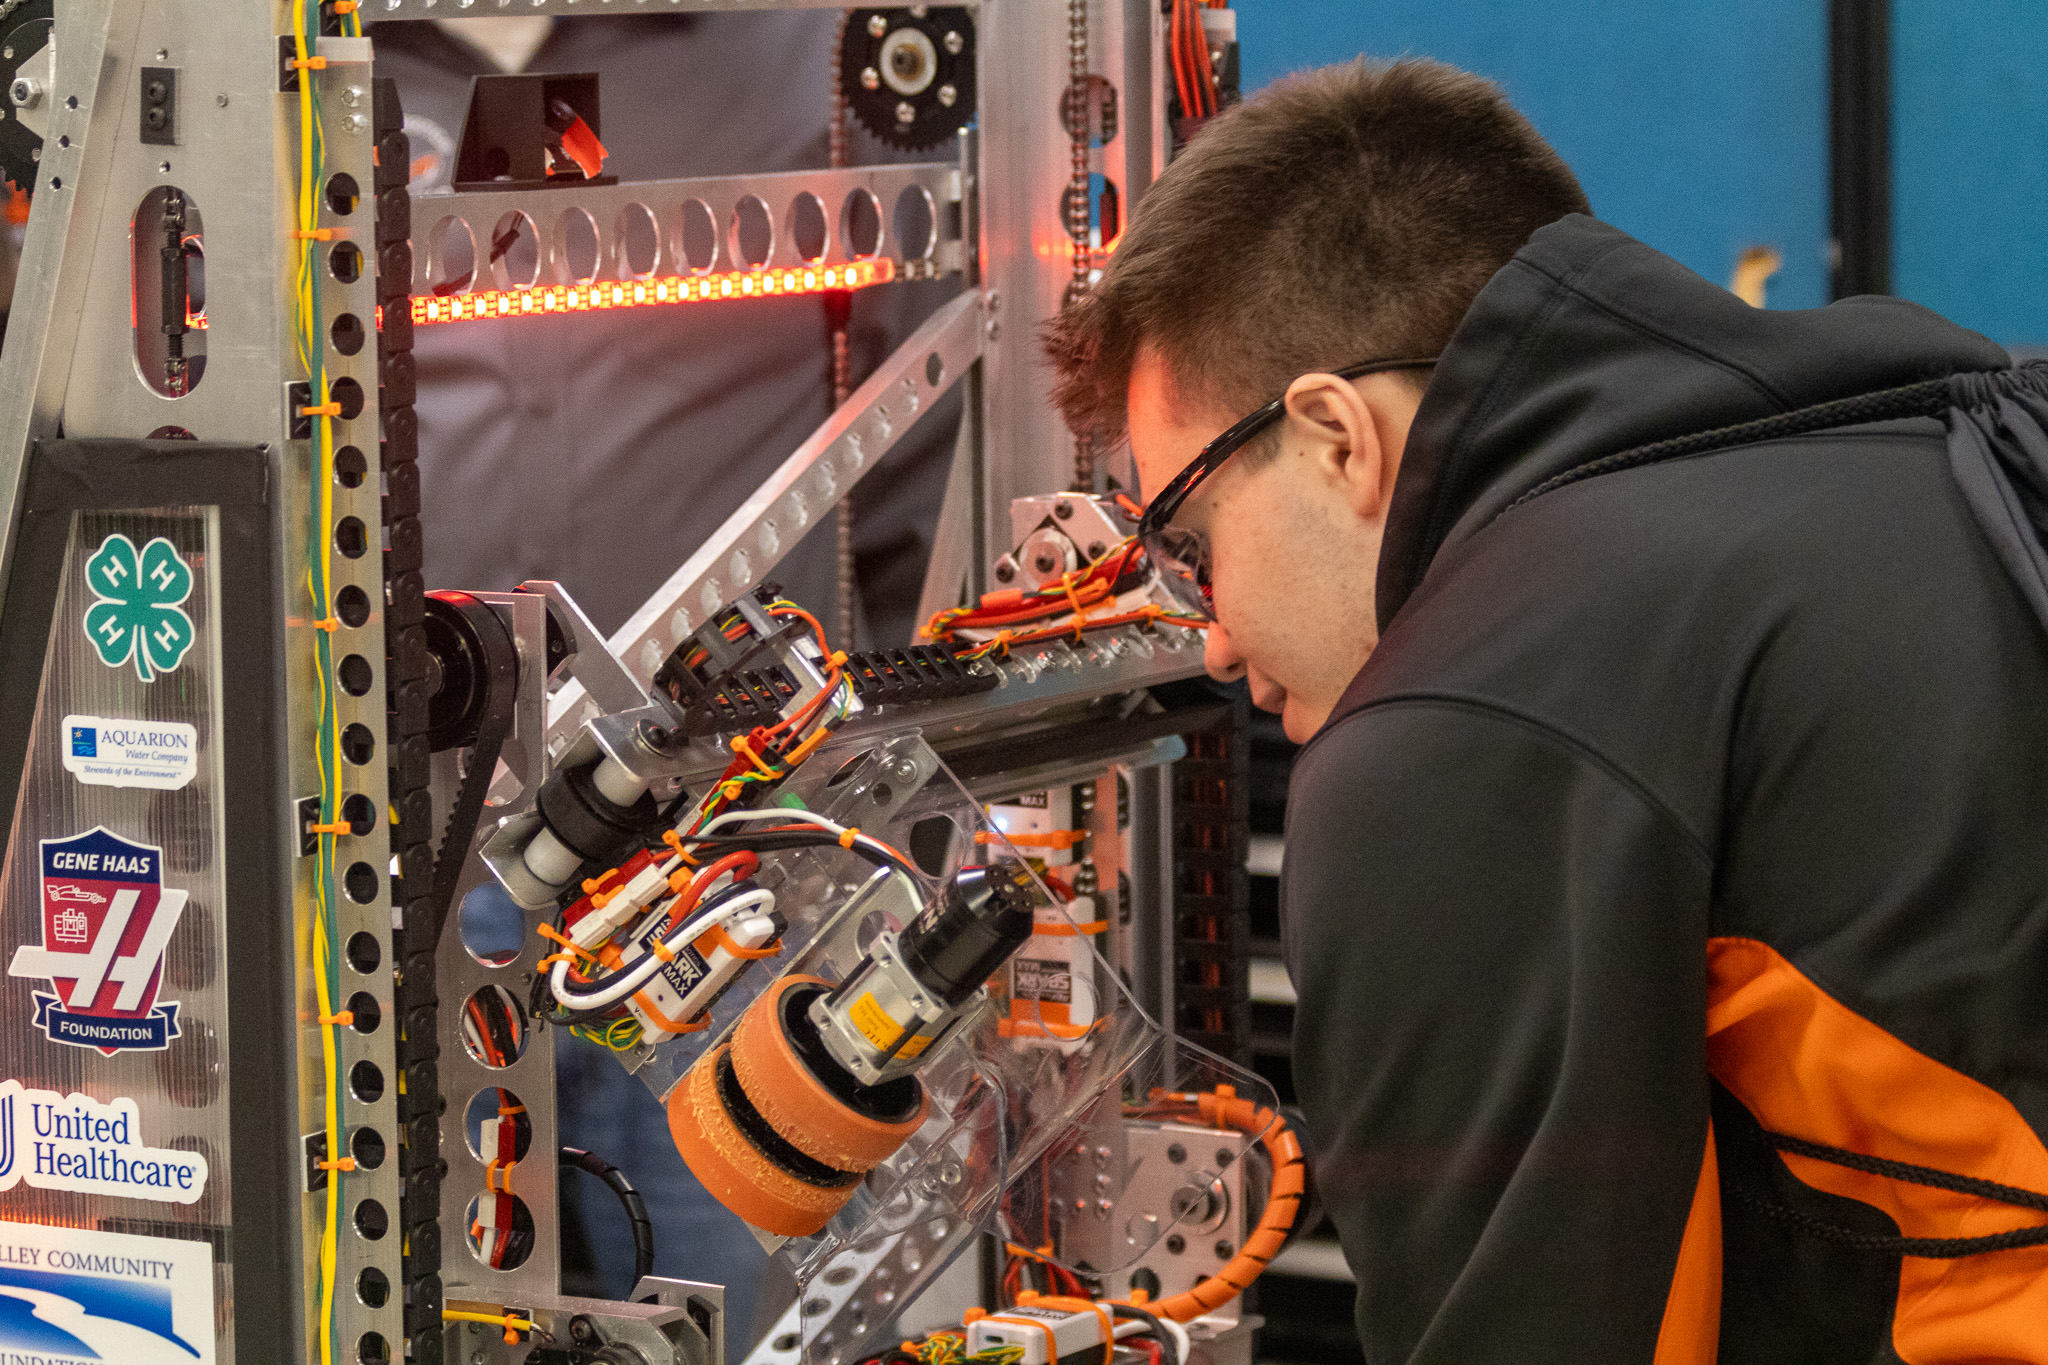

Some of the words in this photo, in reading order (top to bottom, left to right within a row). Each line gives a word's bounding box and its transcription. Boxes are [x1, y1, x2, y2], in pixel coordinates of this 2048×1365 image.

[101, 555, 128, 587] H
[150, 559, 176, 592] H
[98, 615, 125, 647] H
[153, 620, 180, 652] H
[101, 730, 188, 749] AQUARION
[83, 764, 114, 776] Stewards
[114, 767, 122, 777] of
[122, 767, 132, 776] the
[125, 749, 150, 760] Water
[151, 750, 189, 766] Company
[52, 851, 100, 872] GENE
[102, 855, 151, 875] HAAS
[663, 965, 689, 996] MAX
[60, 1021, 153, 1041] FOUNDATION
[31, 1103, 131, 1146] United
[47, 1249, 174, 1280] COMMUNITY
